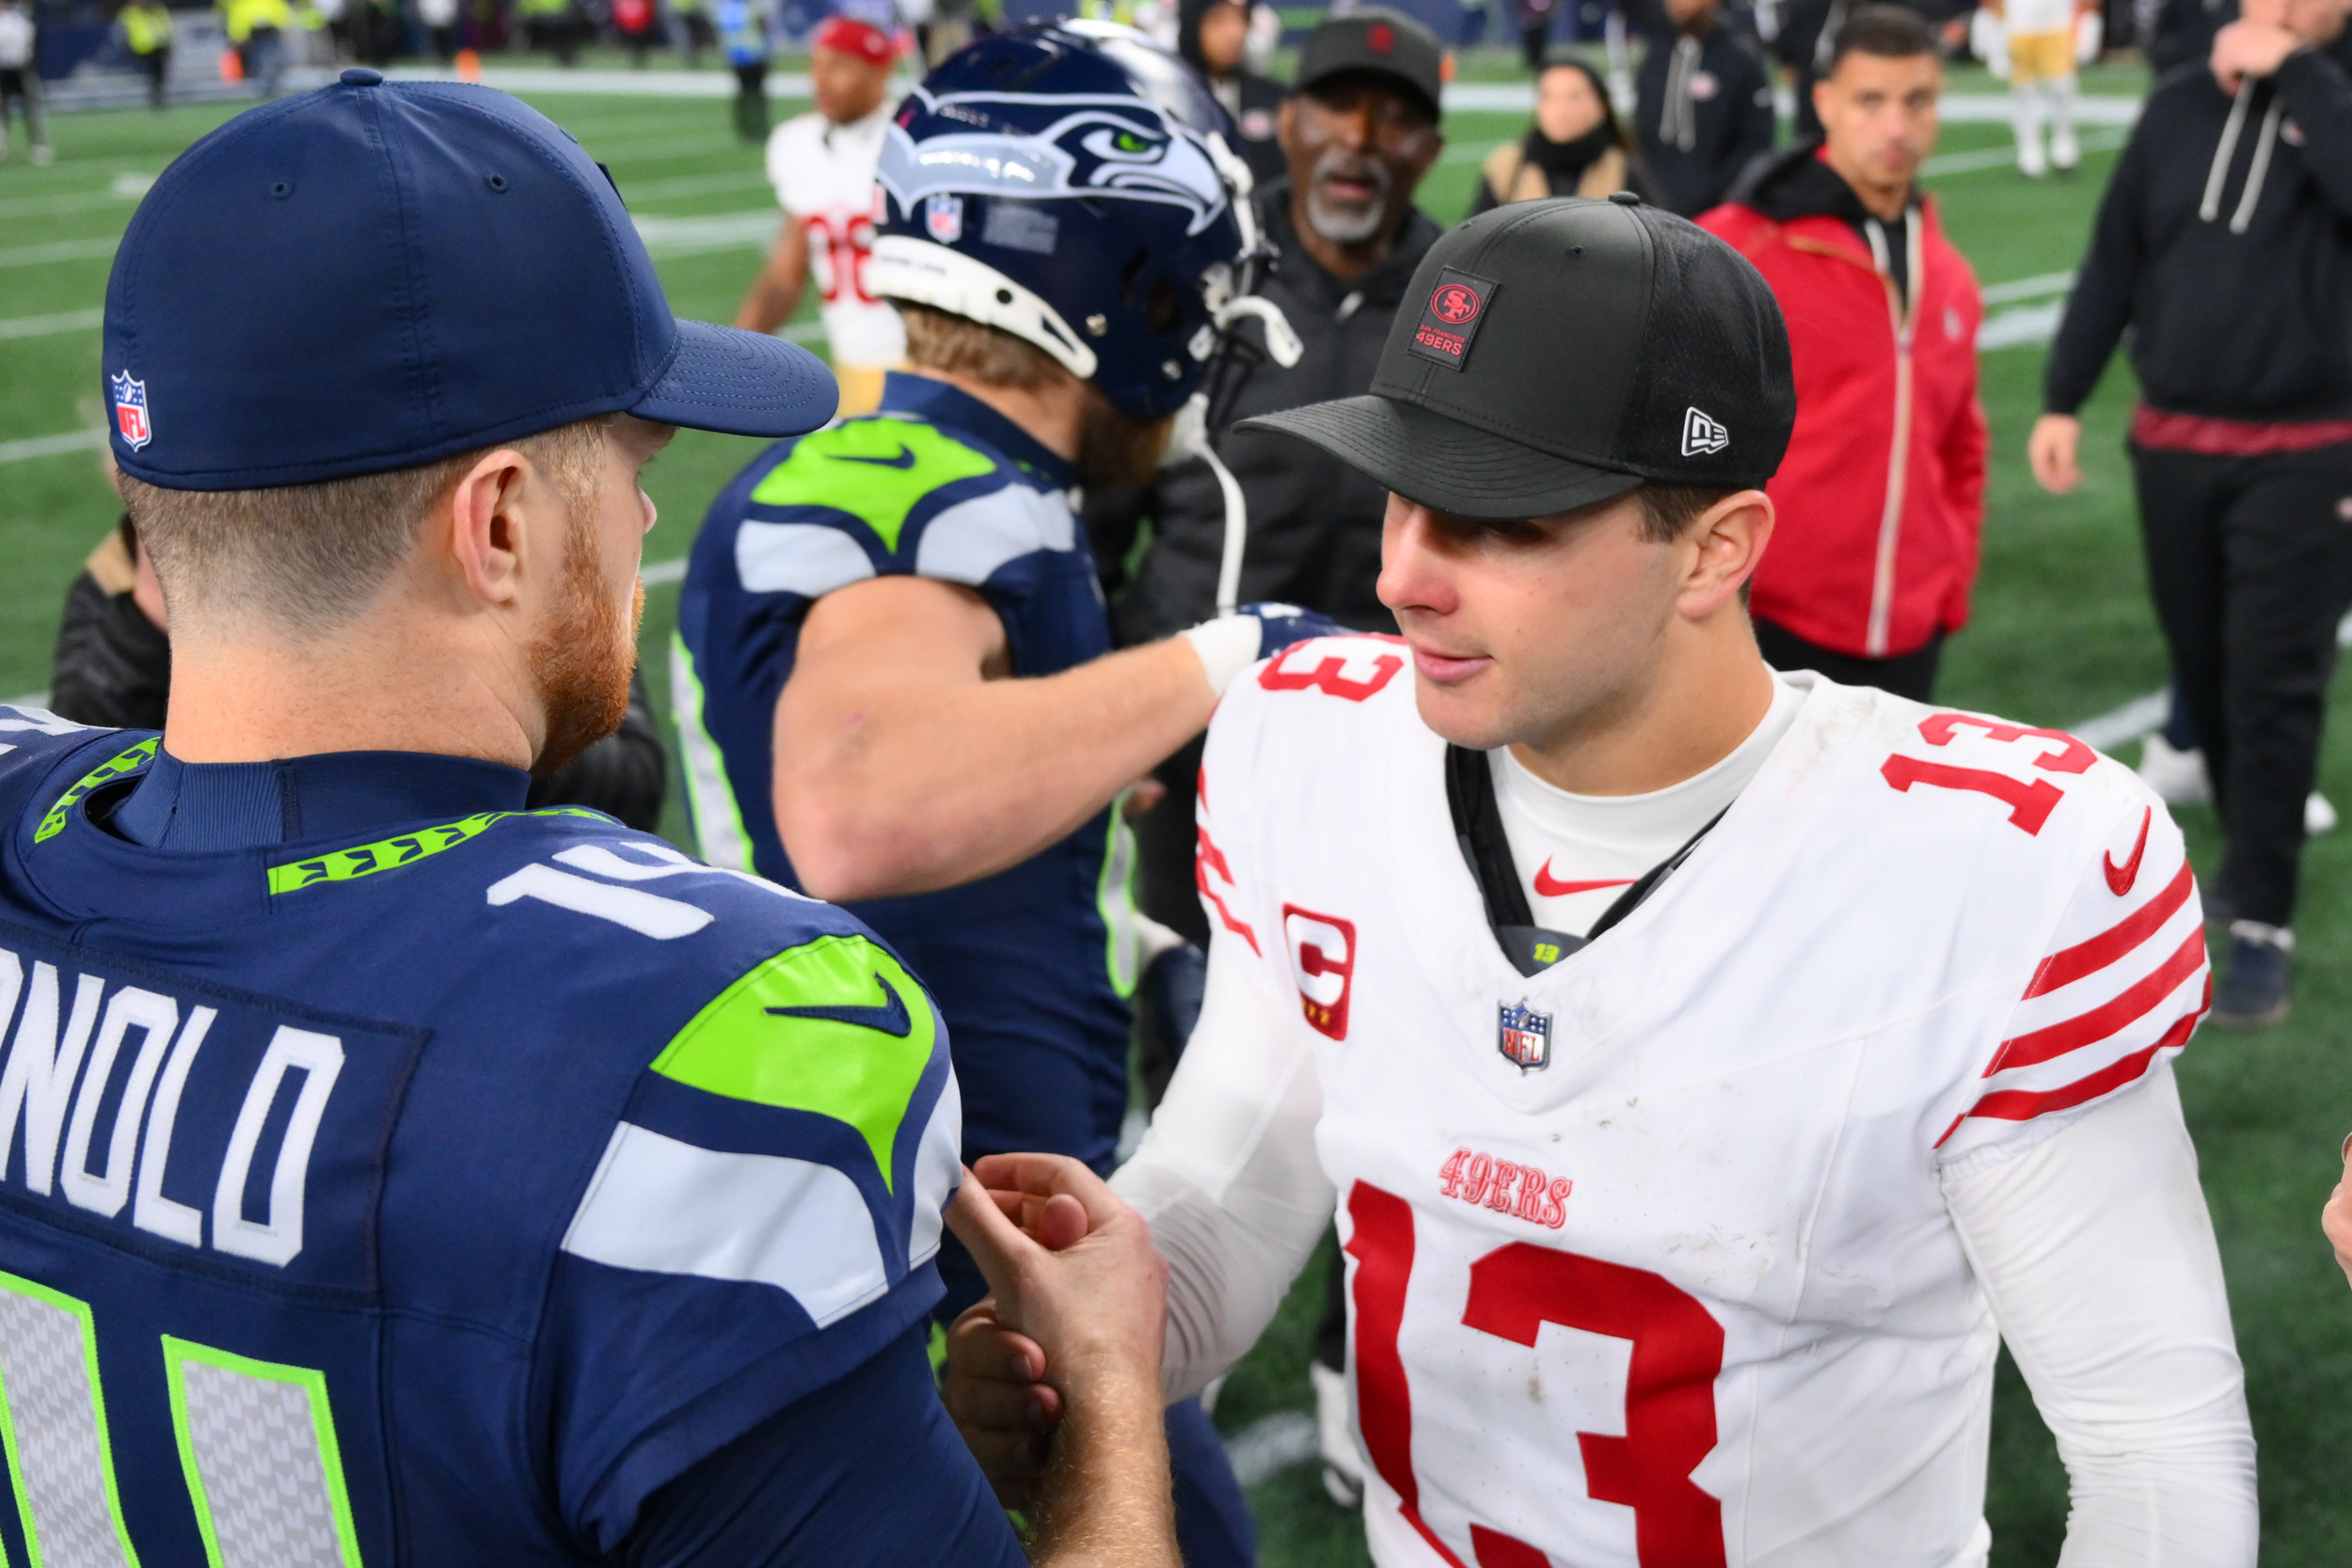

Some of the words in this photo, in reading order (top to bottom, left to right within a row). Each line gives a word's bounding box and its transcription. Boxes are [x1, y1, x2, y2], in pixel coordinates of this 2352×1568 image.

[1415, 331, 1463, 356] 49ERS
[1420, 324, 1432, 332] SAN
[1433, 328, 1466, 343] FRANCISCO
[1880, 713, 2098, 829] 13
[1285, 913, 1348, 1006] C
[1534, 942, 1561, 963] 13
[1503, 1026, 1541, 1065] NFL
[1438, 1146, 1574, 1230] 49ERS
[1343, 1178, 1727, 1568] 13
